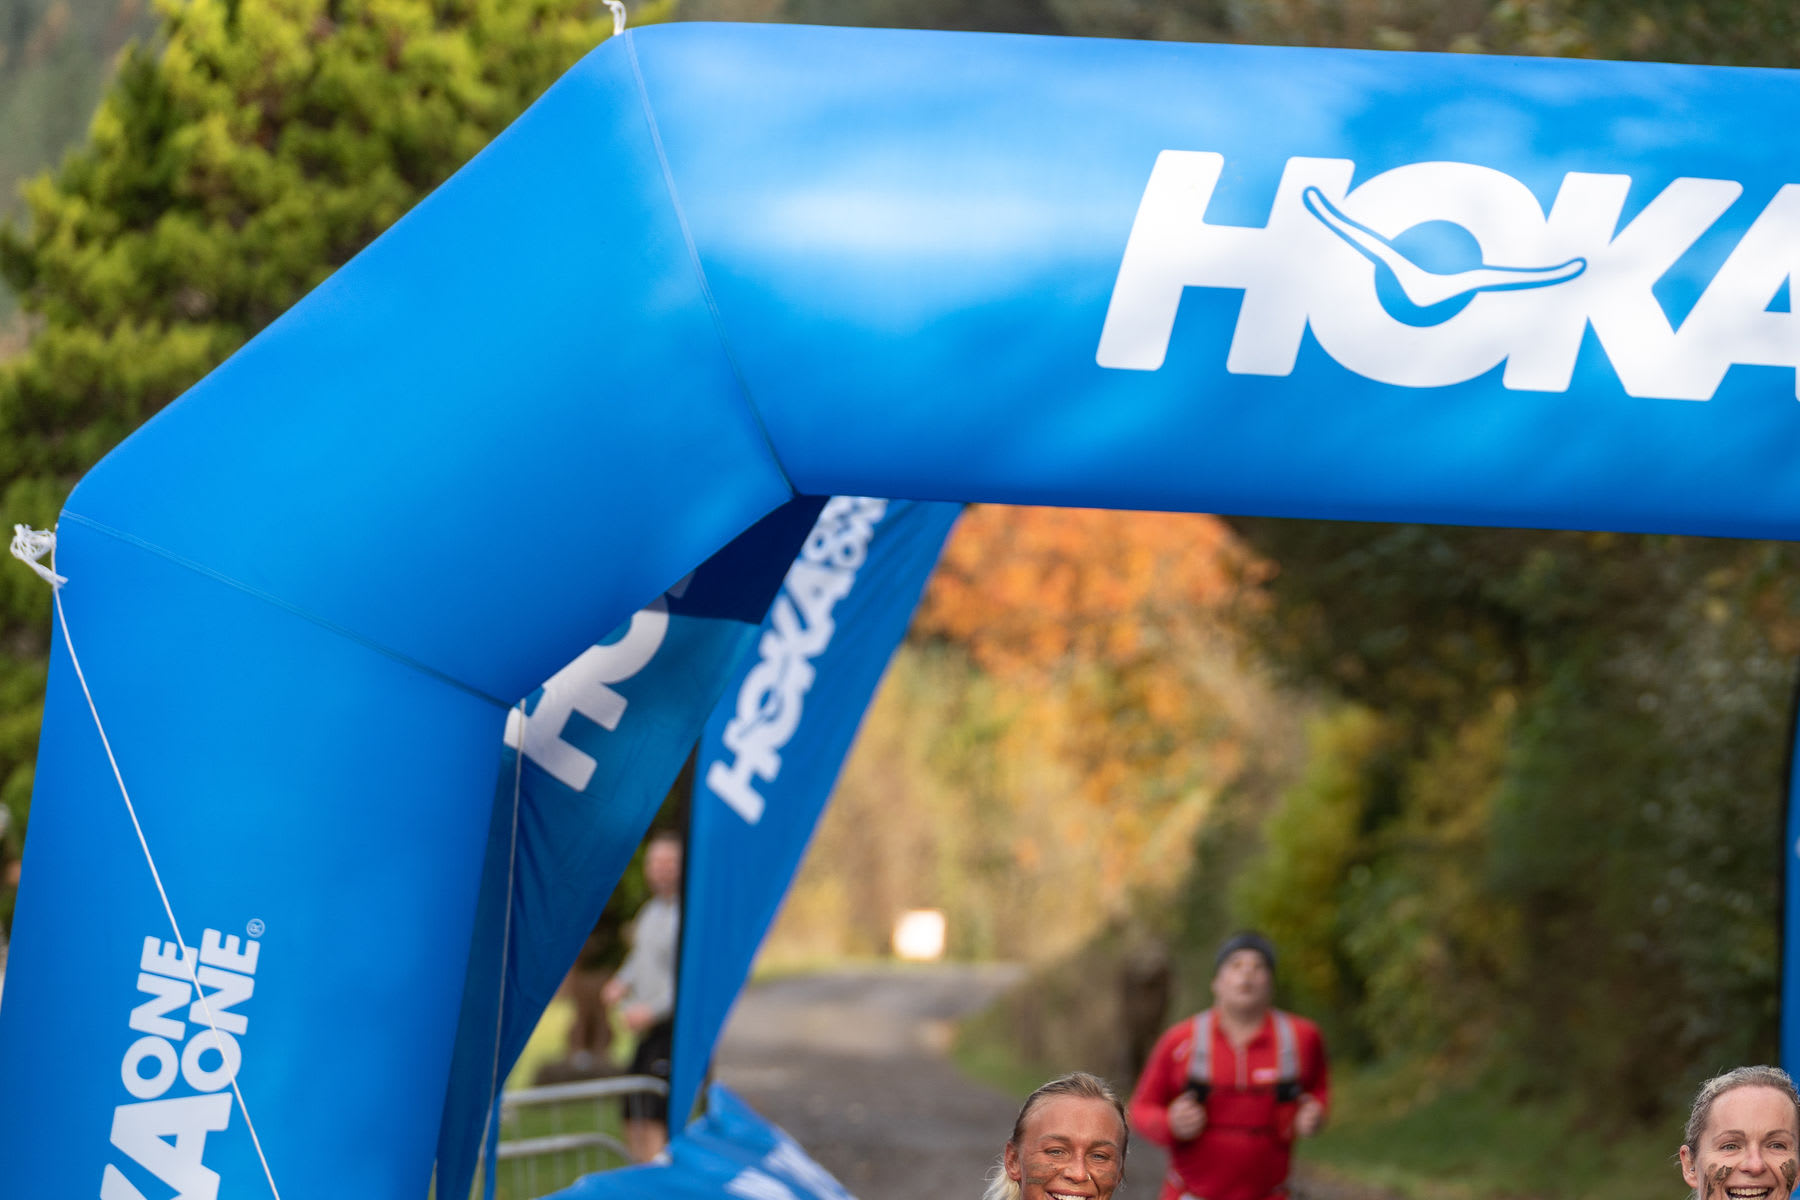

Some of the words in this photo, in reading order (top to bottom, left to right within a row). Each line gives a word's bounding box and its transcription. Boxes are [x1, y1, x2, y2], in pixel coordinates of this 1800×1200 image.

[706, 560, 856, 826] HOKA
[120, 935, 199, 1100] ONE
[181, 927, 262, 1093] ONE
